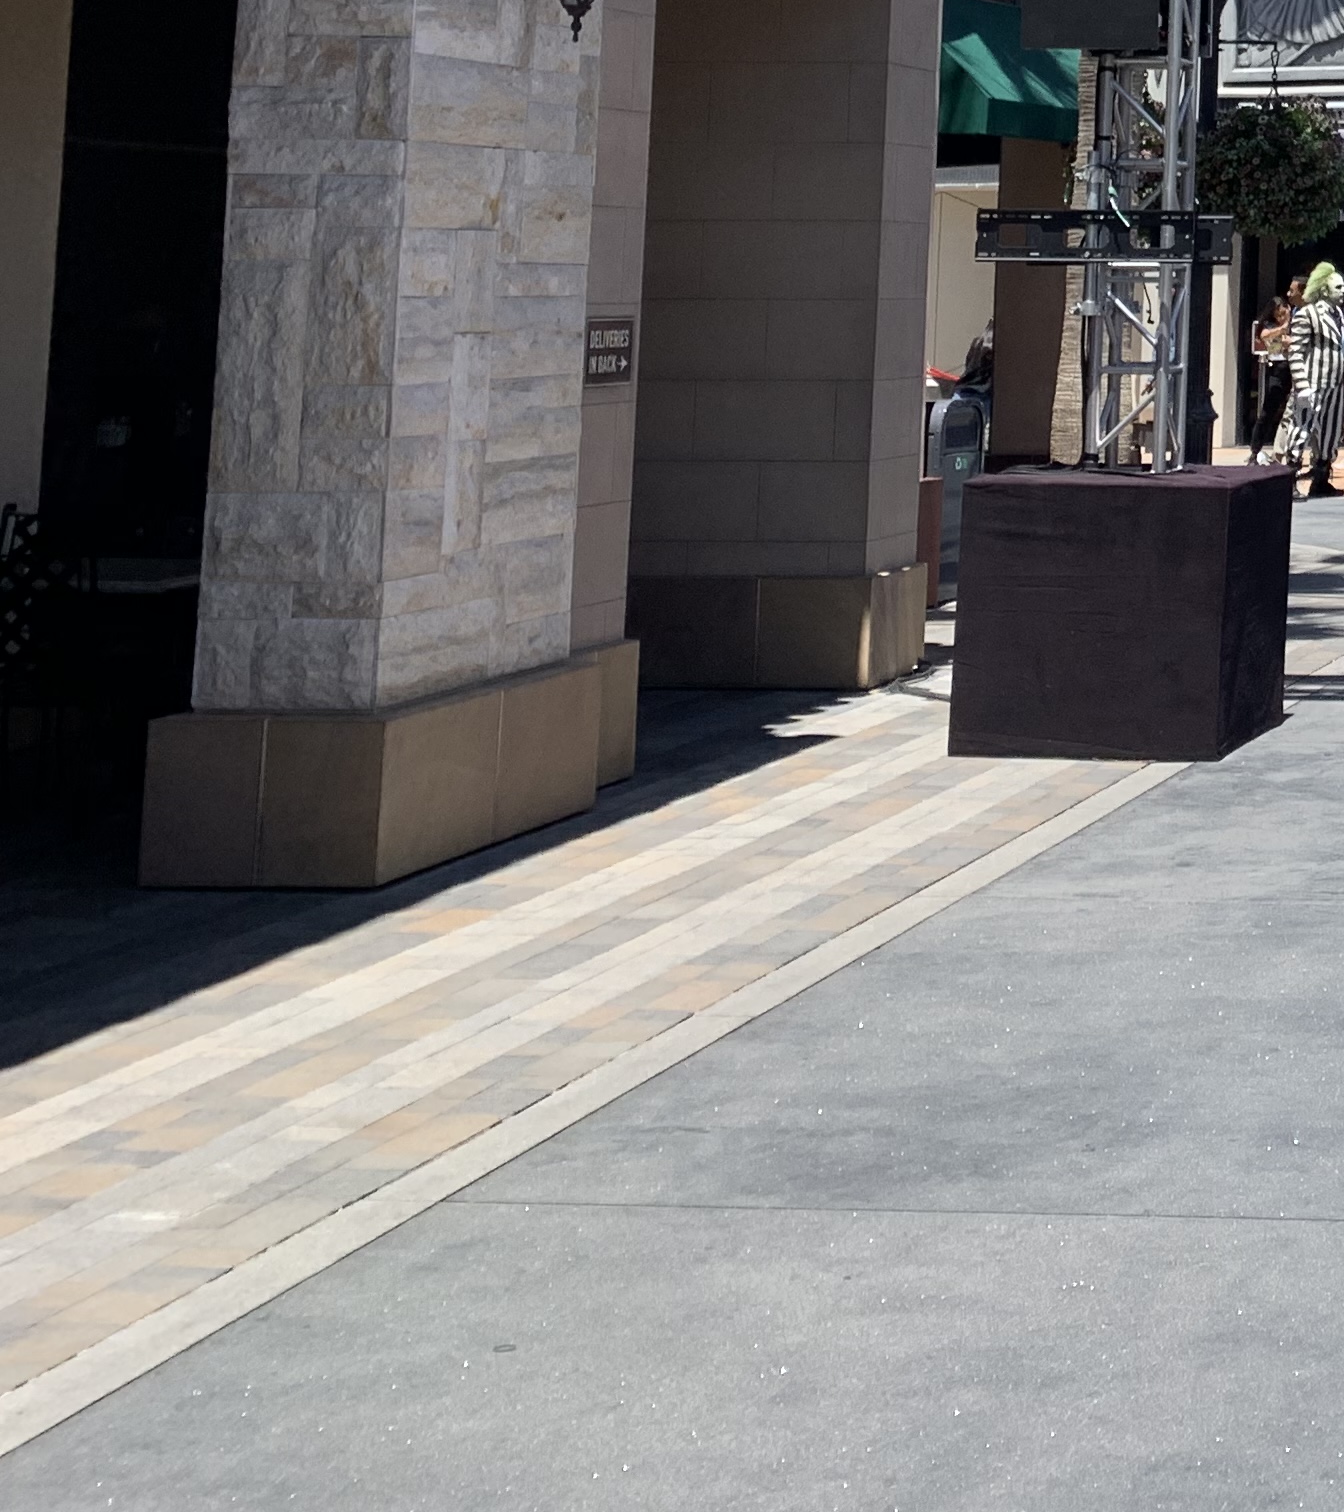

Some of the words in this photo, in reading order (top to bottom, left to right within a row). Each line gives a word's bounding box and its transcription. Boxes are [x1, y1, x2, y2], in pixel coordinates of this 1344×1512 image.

[589, 329, 630, 348] DELIVERIES
[588, 355, 597, 374] IN
[598, 354, 617, 374] BACK
